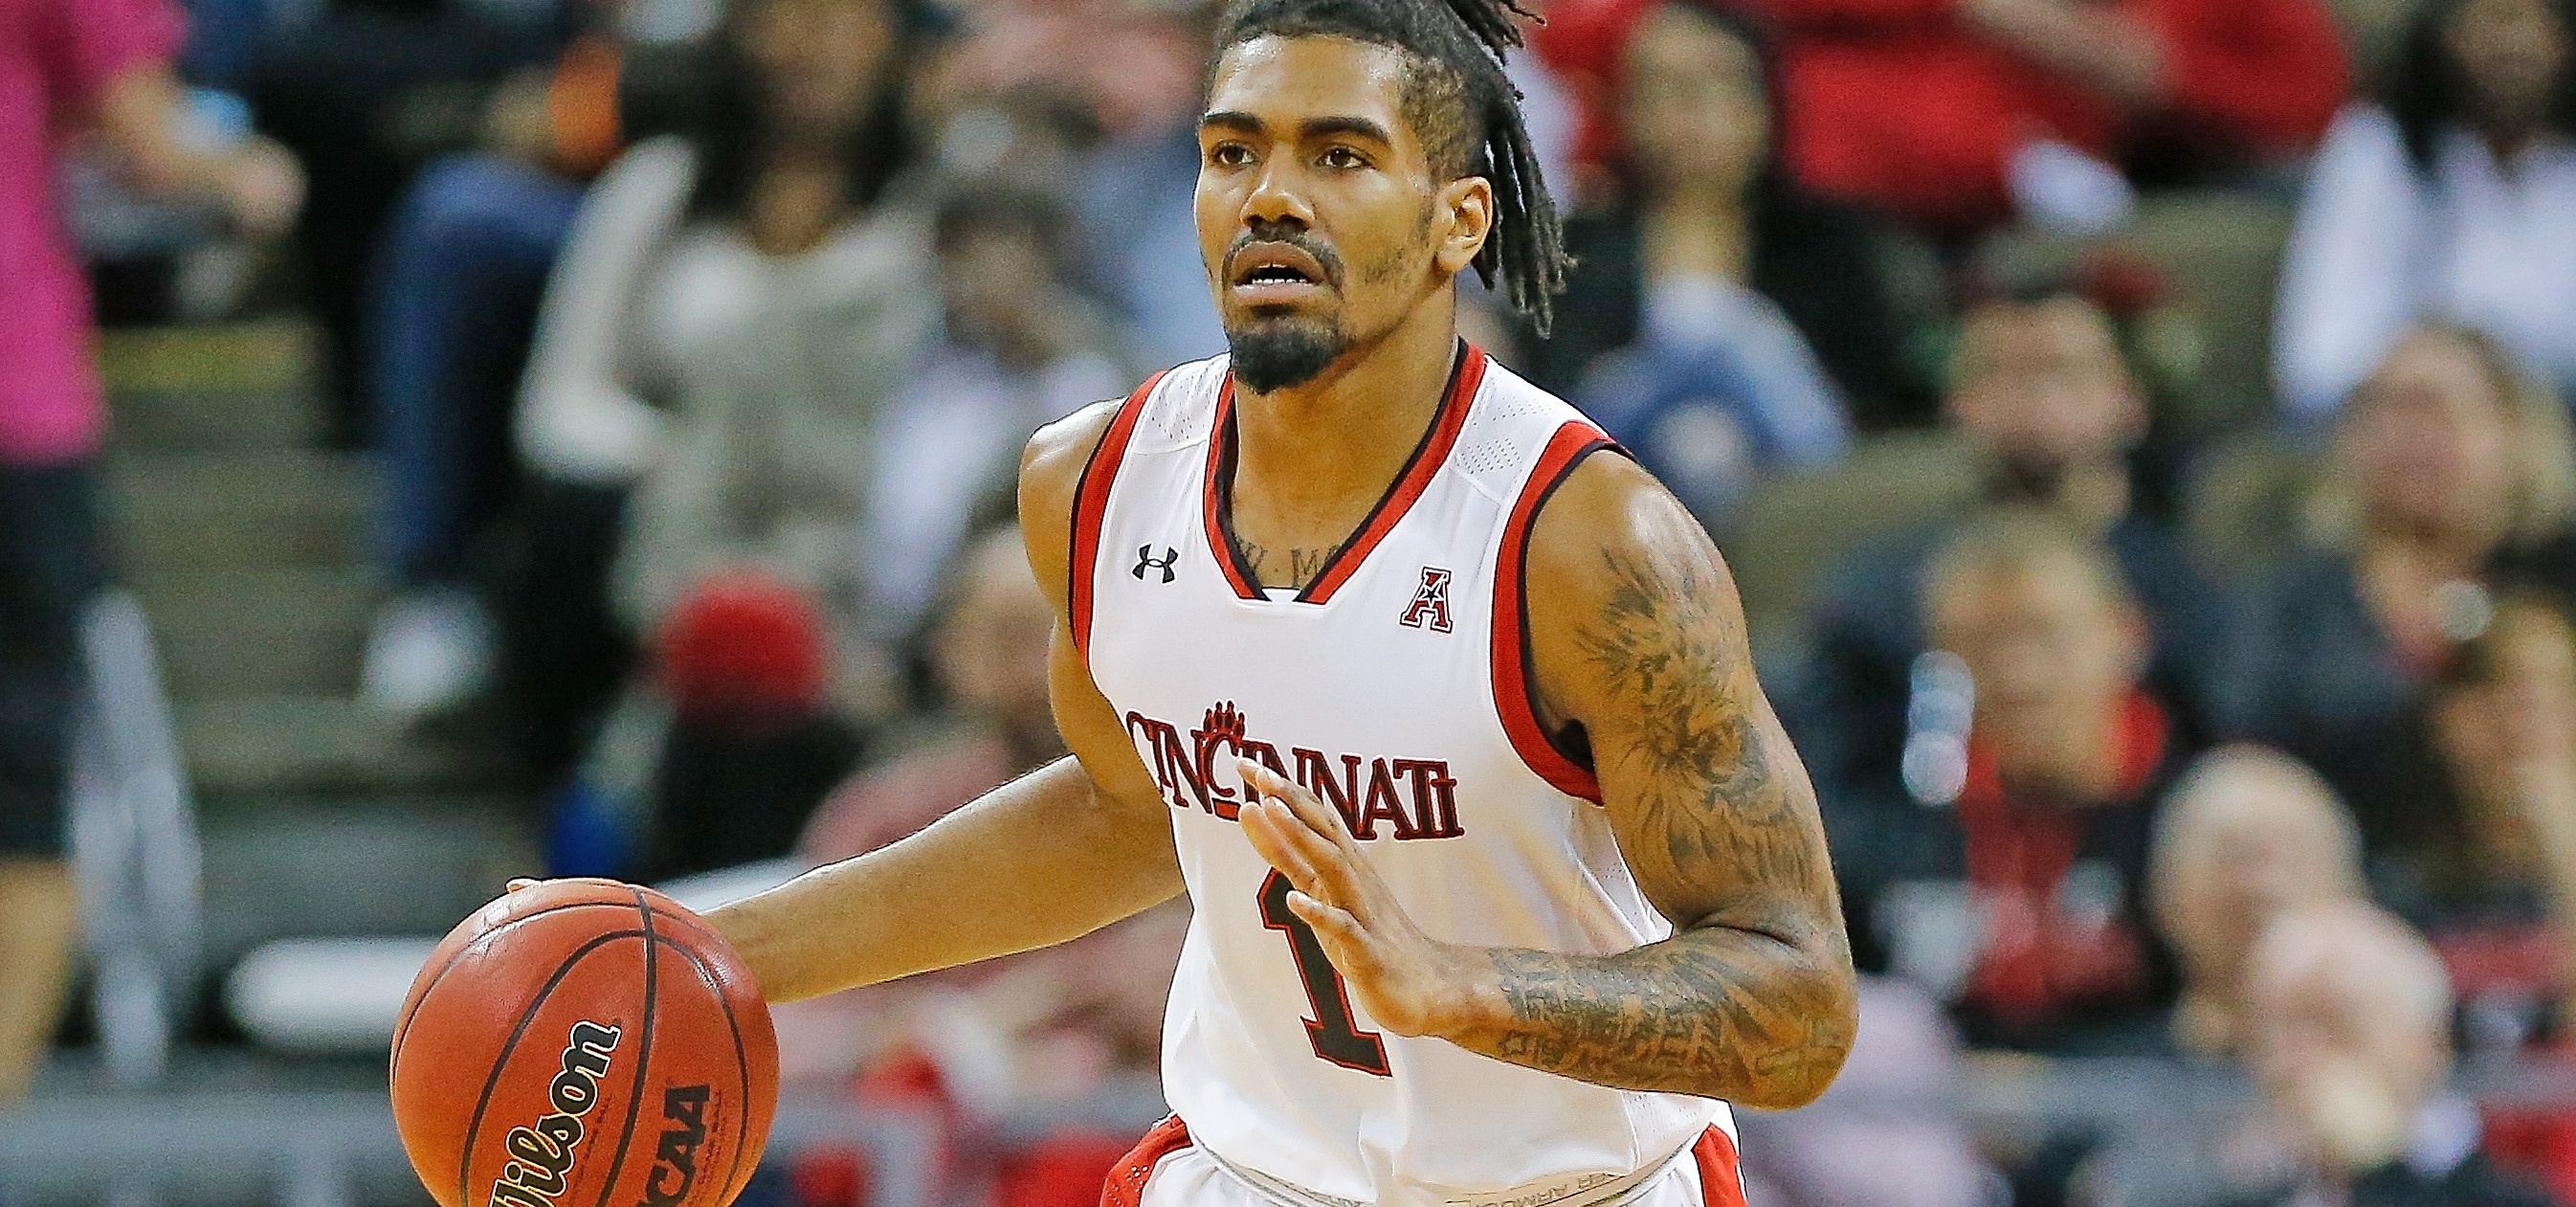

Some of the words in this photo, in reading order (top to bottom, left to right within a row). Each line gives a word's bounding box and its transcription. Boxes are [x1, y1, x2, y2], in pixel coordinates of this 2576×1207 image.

[1400, 567, 1454, 633] A
[1255, 866, 1392, 1078] 1
[634, 1084, 710, 1207] CAA
